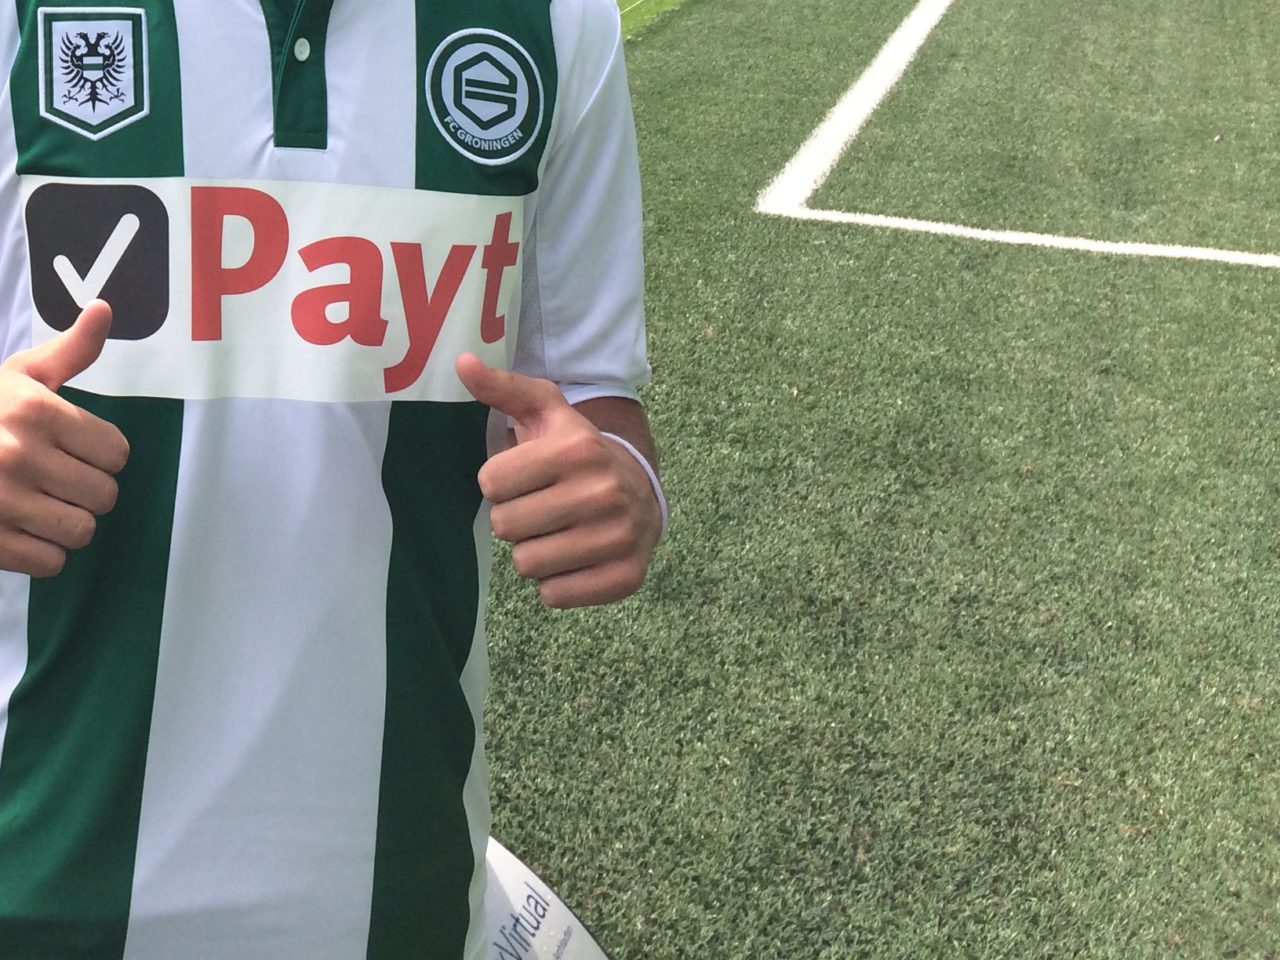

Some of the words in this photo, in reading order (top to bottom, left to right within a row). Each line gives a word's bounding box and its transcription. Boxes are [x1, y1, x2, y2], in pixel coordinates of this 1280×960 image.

[443, 115, 458, 132] FC
[457, 128, 524, 151] GRONINGEN
[190, 186, 521, 394] Payt
[493, 881, 551, 960] Virtual
